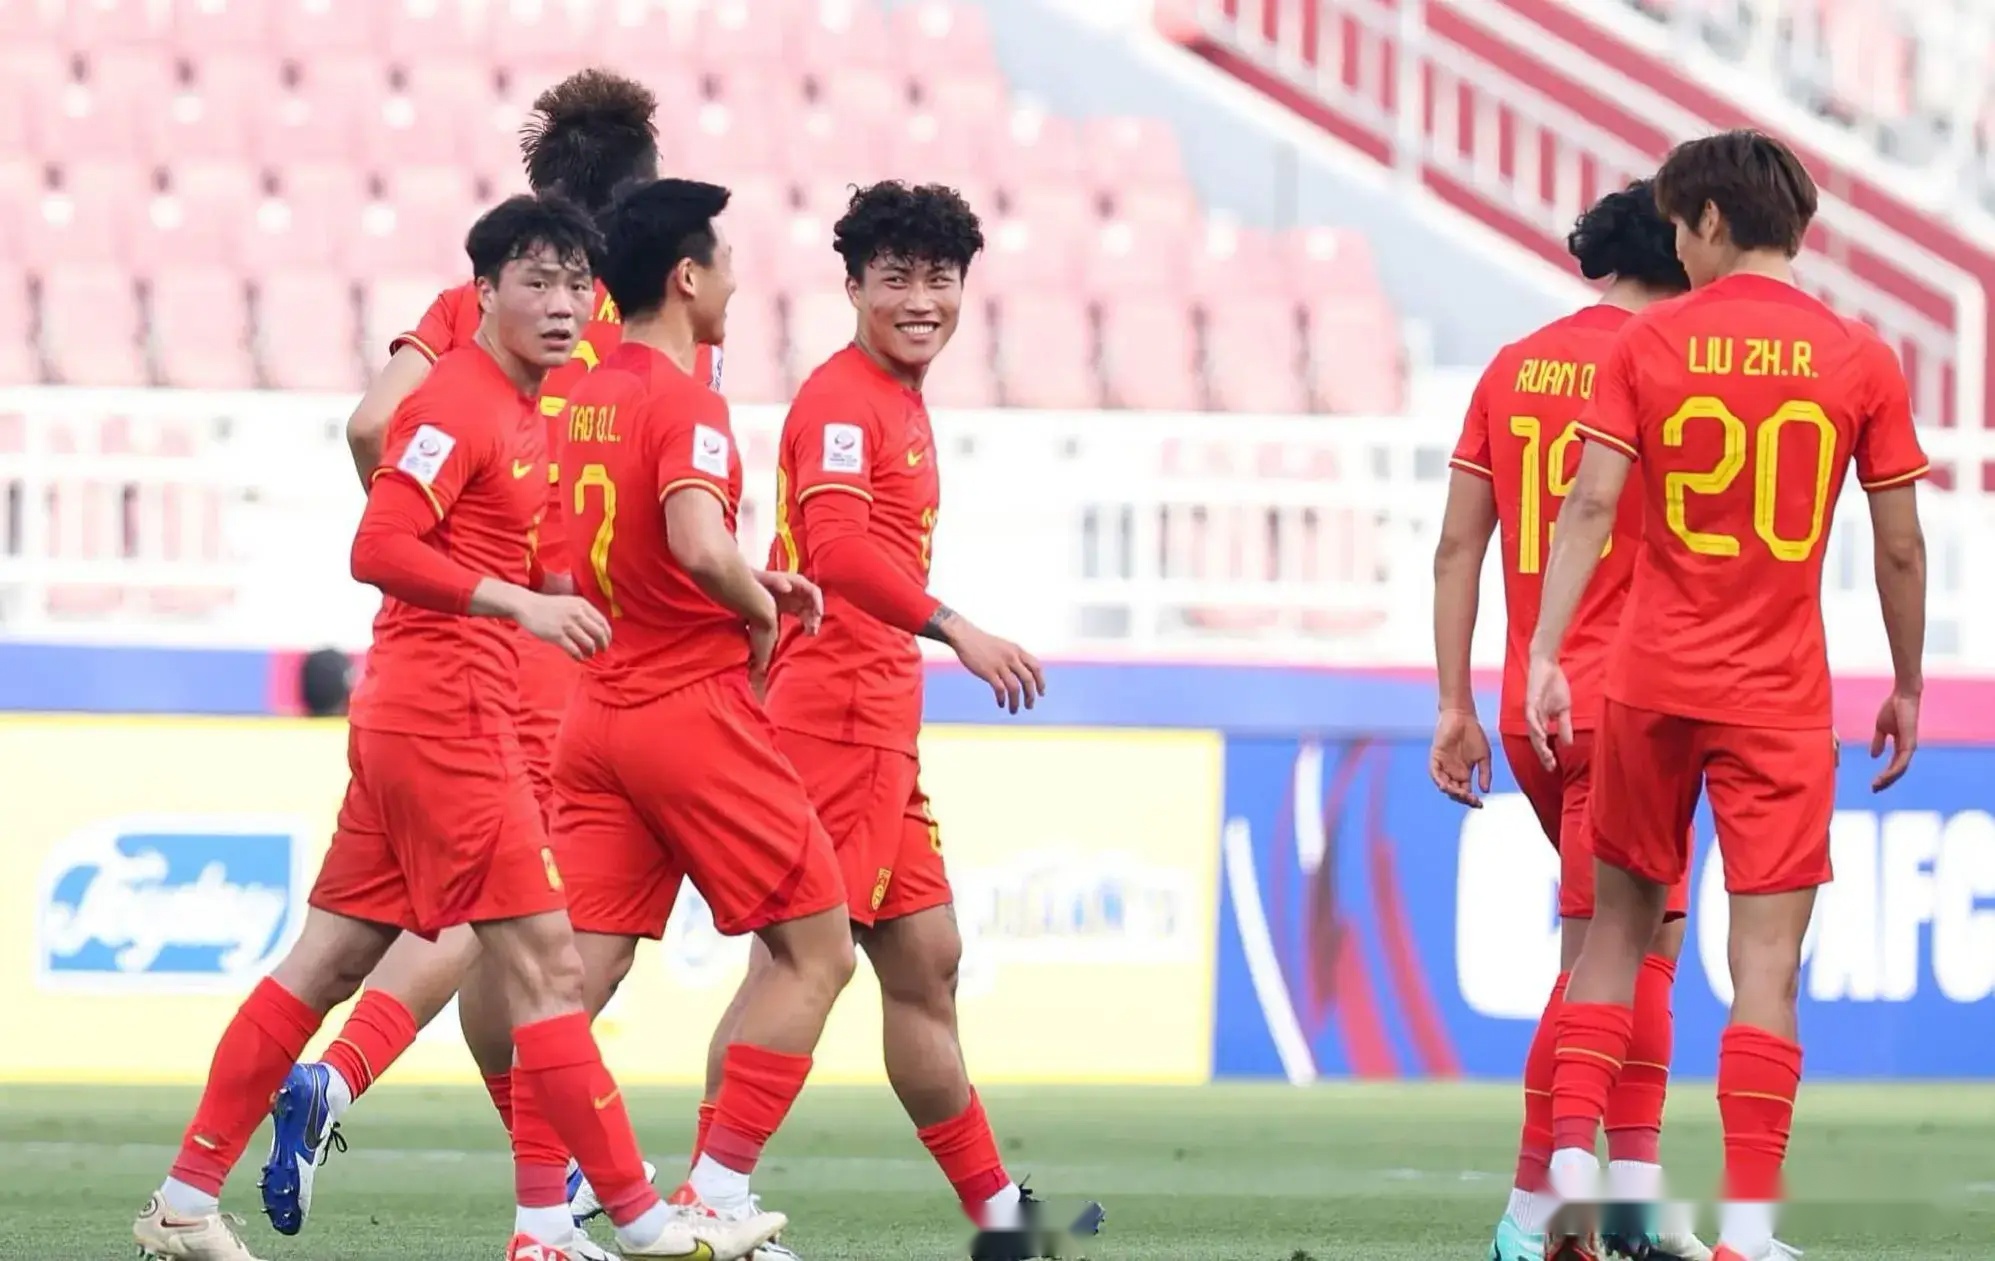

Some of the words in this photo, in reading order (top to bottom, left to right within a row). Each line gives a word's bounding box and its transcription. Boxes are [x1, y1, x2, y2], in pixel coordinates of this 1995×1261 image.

[1514, 358, 1578, 398] RUAN
[1688, 336, 1734, 375] LIU
[568, 405, 594, 443] TAO
[596, 404, 621, 444] Q.L.
[1663, 396, 1838, 562] 20
[574, 463, 623, 618] 7
[1808, 809, 1995, 1003] AFC
